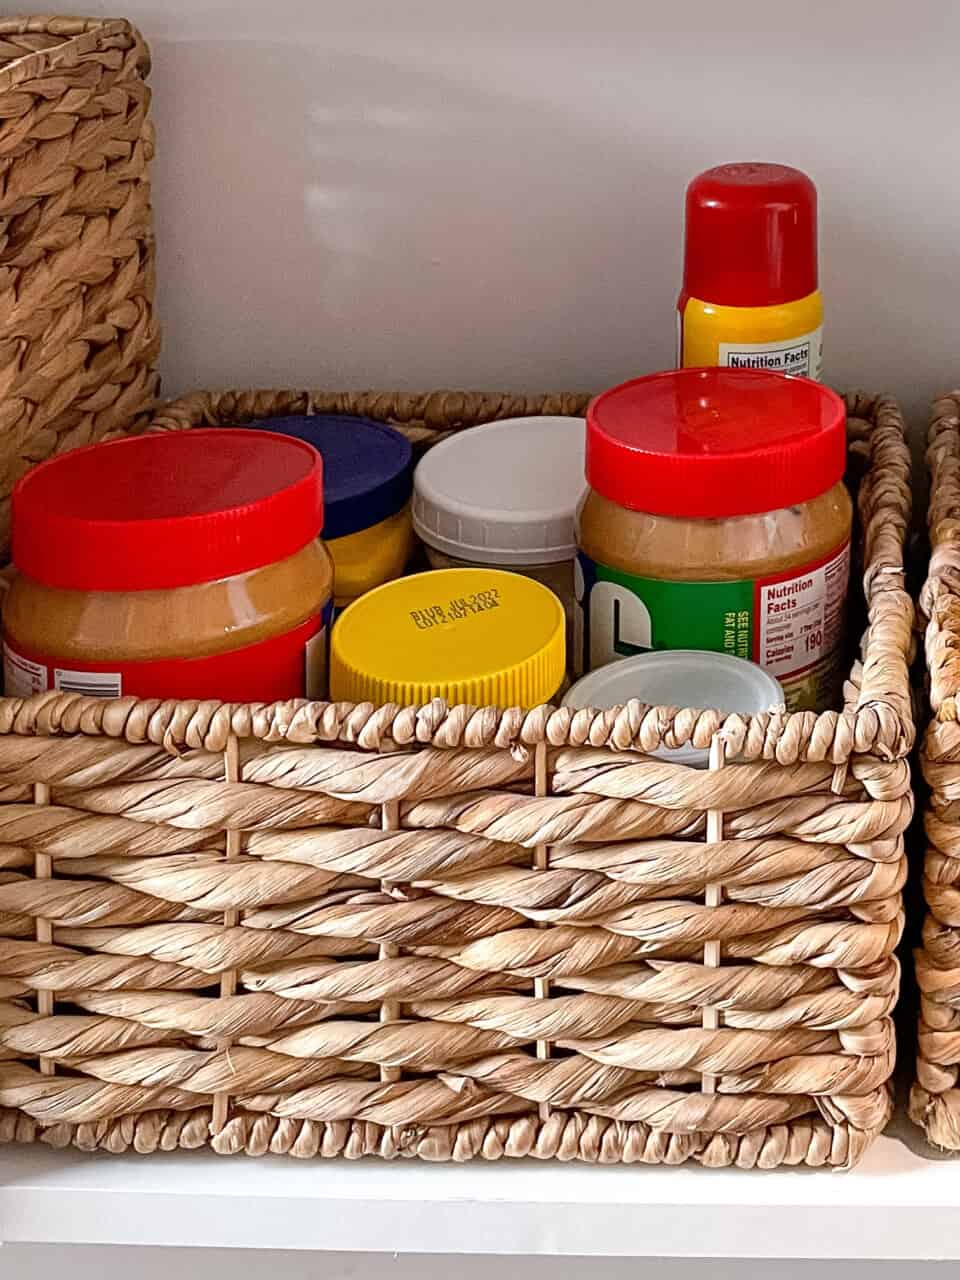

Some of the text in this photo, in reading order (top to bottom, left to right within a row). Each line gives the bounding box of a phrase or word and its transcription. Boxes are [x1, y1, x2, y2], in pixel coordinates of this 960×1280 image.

[731, 348, 807, 369] Nutrition Facts
[767, 578, 813, 600] Nutrition
[767, 598, 797, 614] Facts
[724, 612, 736, 627] FAT
[738, 611, 749, 629] SEE
[724, 629, 736, 648] AND
[805, 630, 822, 652] 190
